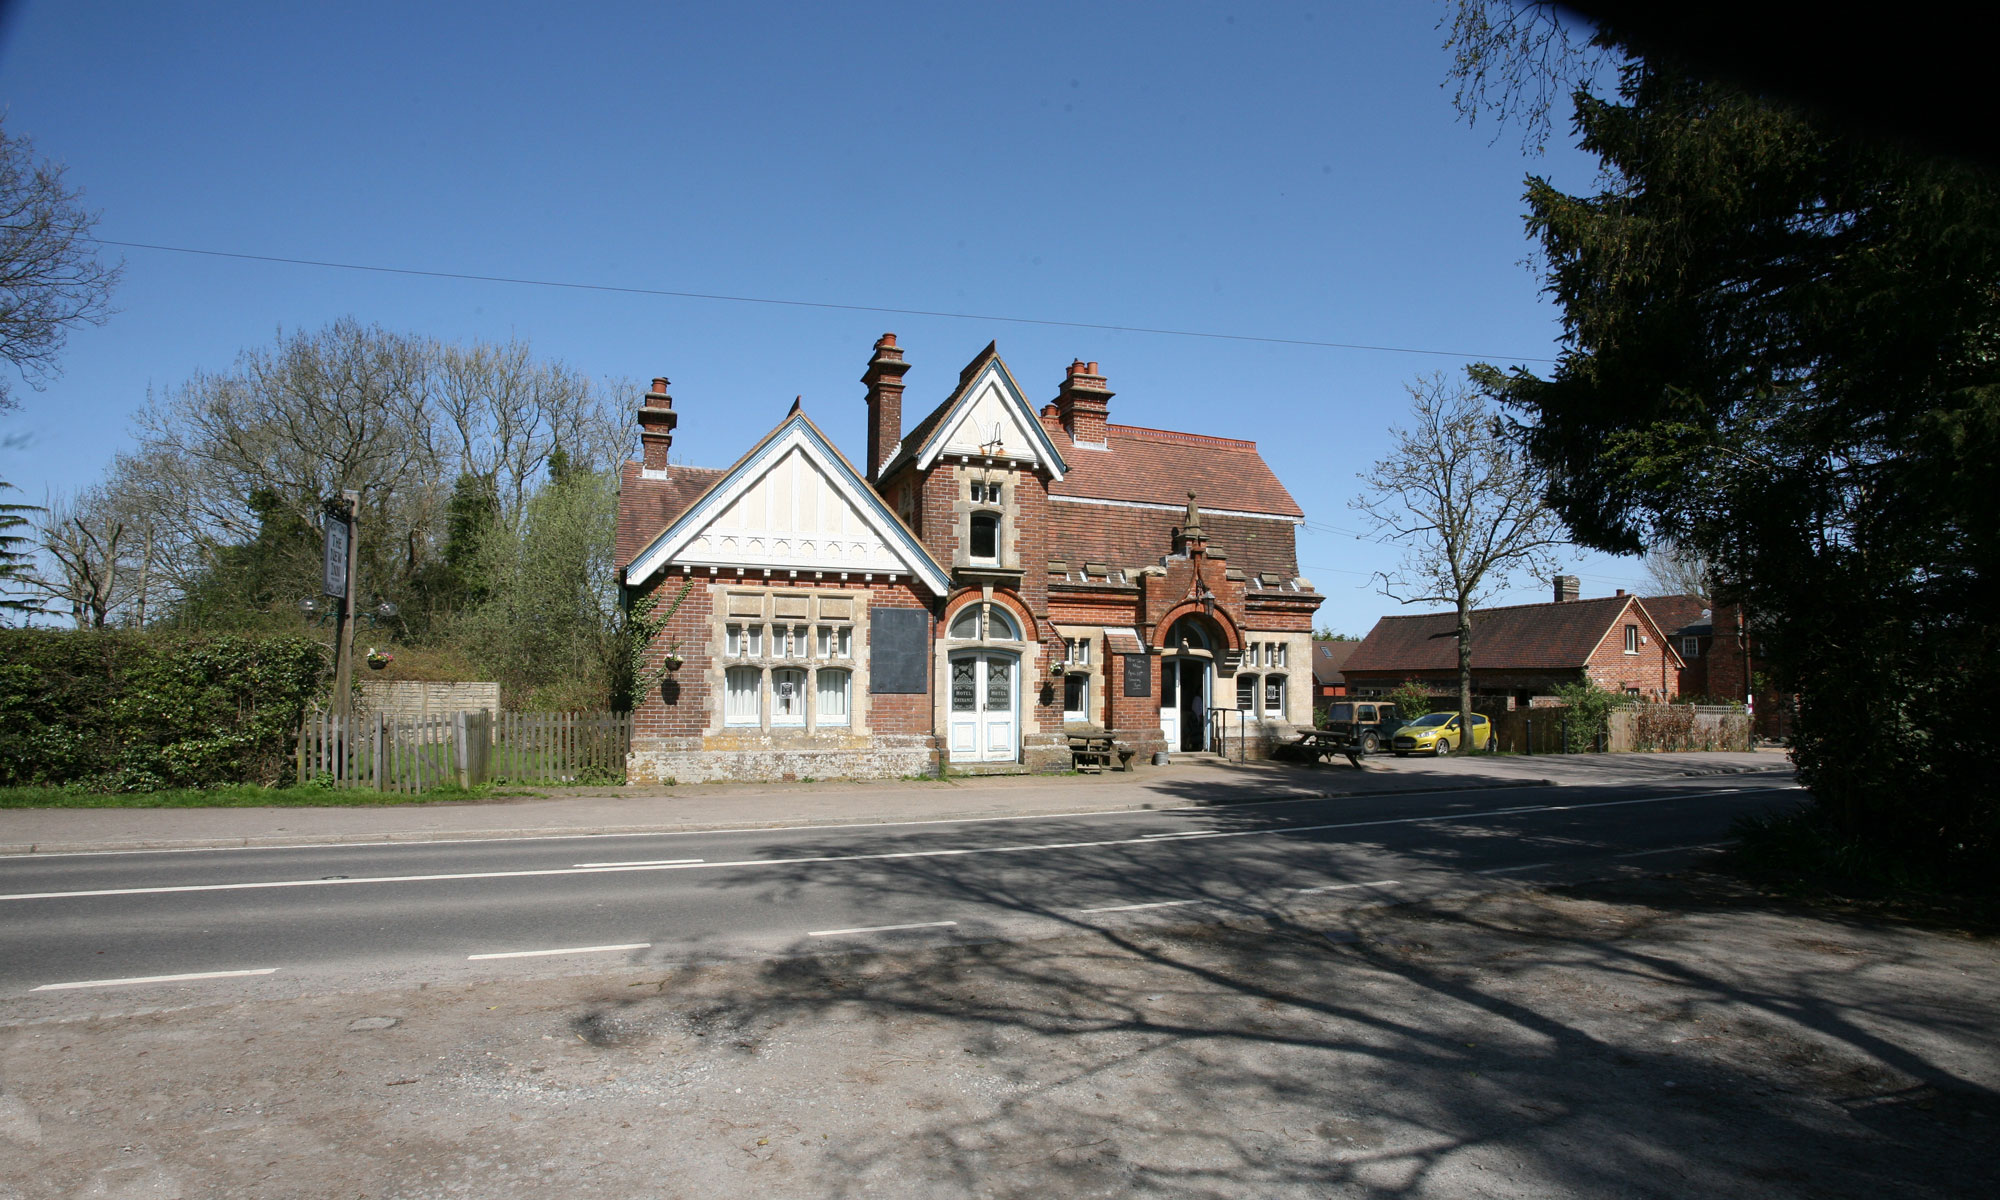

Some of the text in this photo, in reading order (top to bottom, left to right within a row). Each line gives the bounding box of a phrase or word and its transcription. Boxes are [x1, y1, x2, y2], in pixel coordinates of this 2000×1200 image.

[332, 534, 342, 550] THE
[330, 548, 343, 564] NEW
[330, 562, 341, 577] INN
